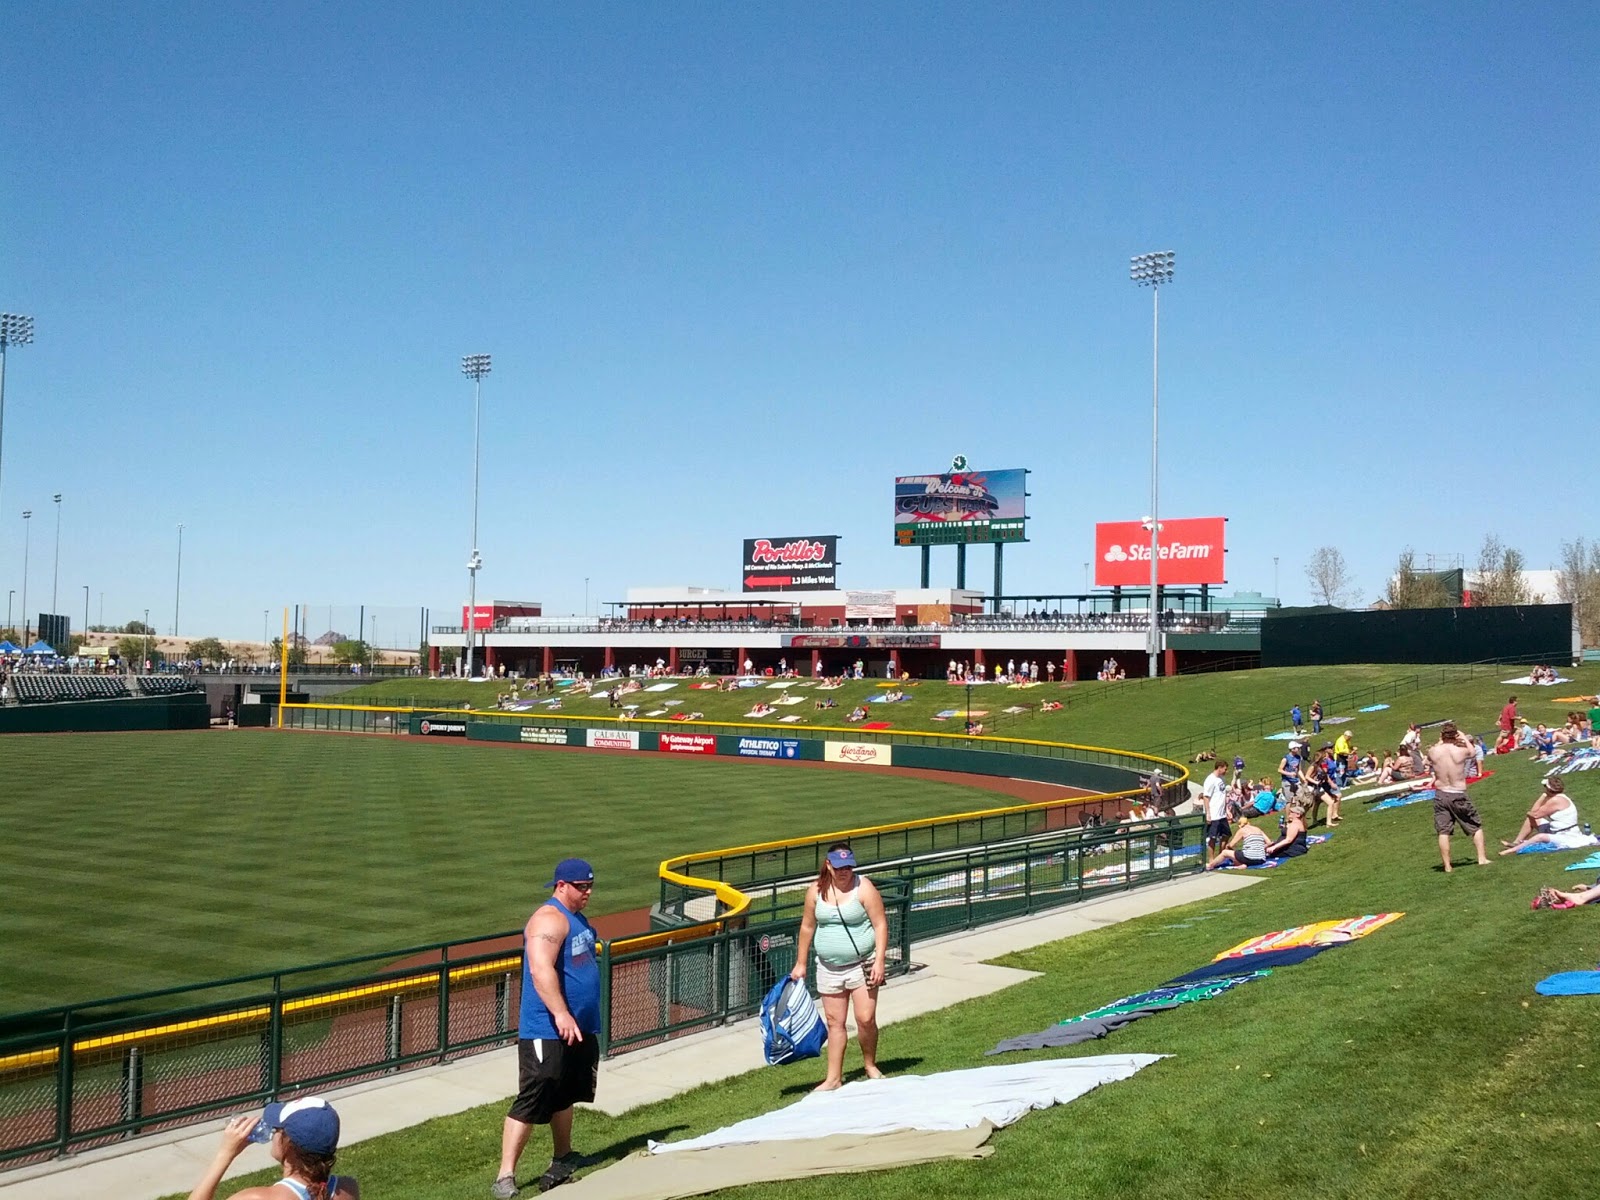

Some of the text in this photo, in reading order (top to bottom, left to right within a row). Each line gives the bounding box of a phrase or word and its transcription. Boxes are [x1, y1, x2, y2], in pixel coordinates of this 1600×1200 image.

[925, 479, 984, 497] Welcome To
[896, 496, 953, 513] CUBS
[752, 540, 826, 563] Portillo's
[1169, 543, 1209, 559] Farm
[801, 575, 818, 585] Miles
[818, 575, 835, 584] West
[679, 649, 708, 659] BURGER
[594, 730, 609, 738] CAL
[661, 734, 714, 746] Fly Gateway Airport
[739, 738, 780, 750] ATHLETICO
[839, 745, 877, 759] Giordano's
